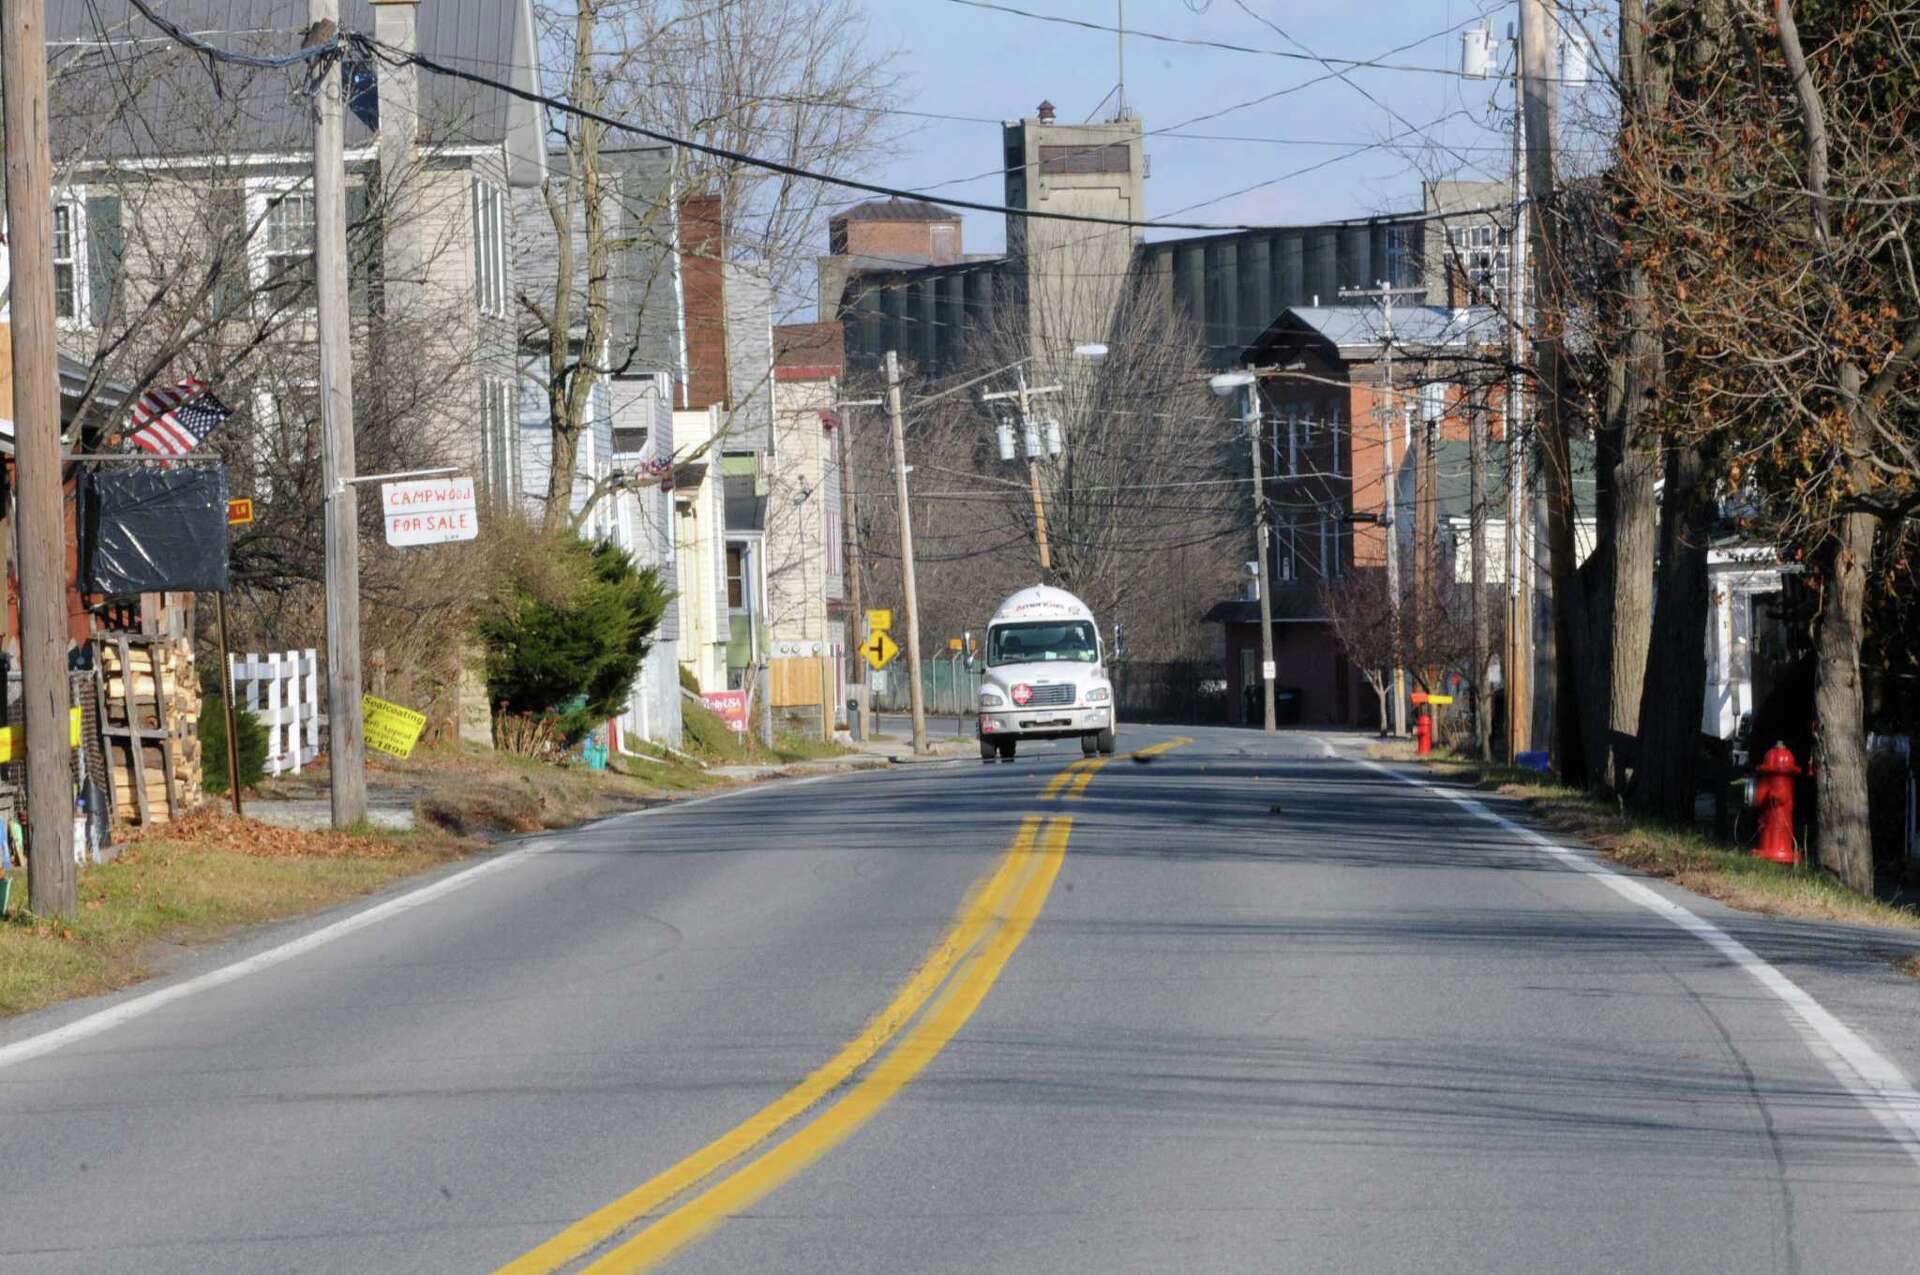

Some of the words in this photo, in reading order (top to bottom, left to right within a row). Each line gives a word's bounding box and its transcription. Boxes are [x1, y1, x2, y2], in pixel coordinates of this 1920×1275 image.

[392, 518, 421, 533] FOR
[426, 513, 469, 531] SALE
[364, 697, 425, 725] Sealcoating
